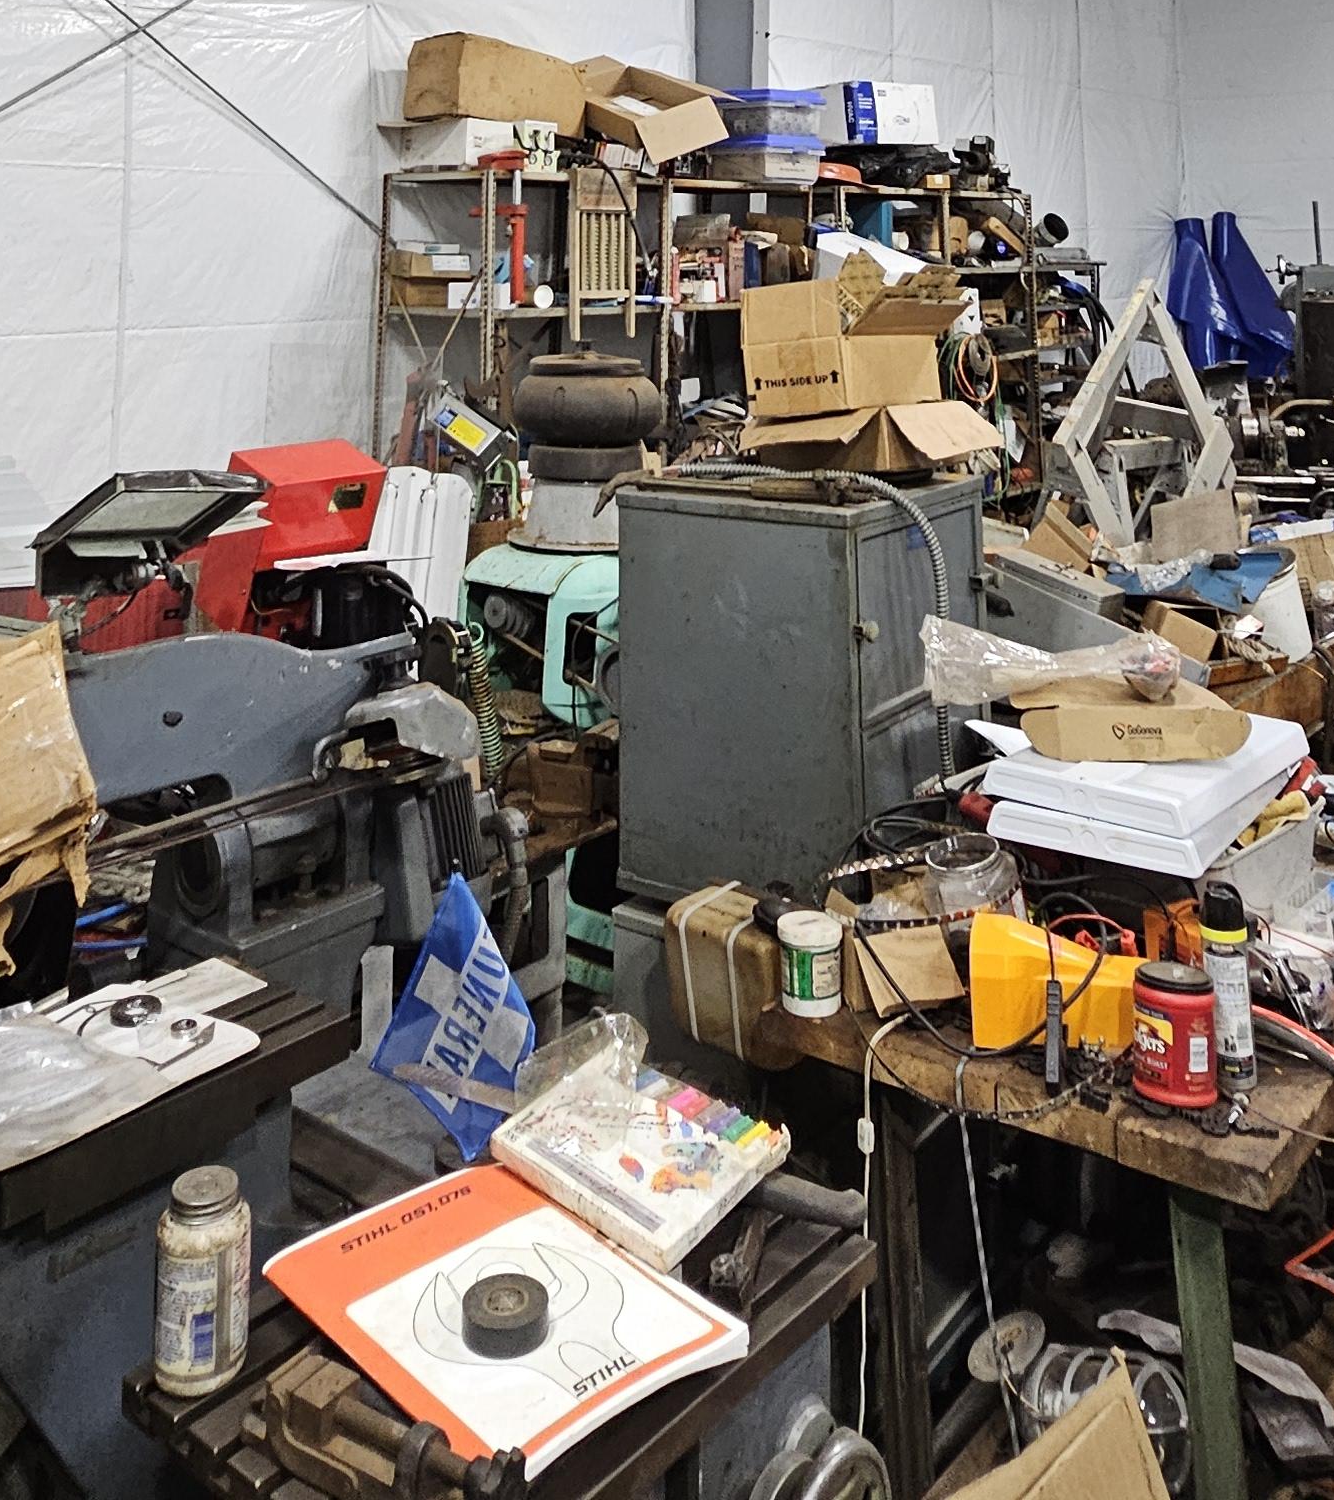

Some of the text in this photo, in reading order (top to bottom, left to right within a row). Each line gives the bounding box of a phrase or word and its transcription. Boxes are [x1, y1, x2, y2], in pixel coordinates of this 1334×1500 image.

[764, 375, 828, 389] THIS SIDE UP
[340, 1223, 398, 1254] STIHL
[572, 1356, 636, 1397] STIHL
